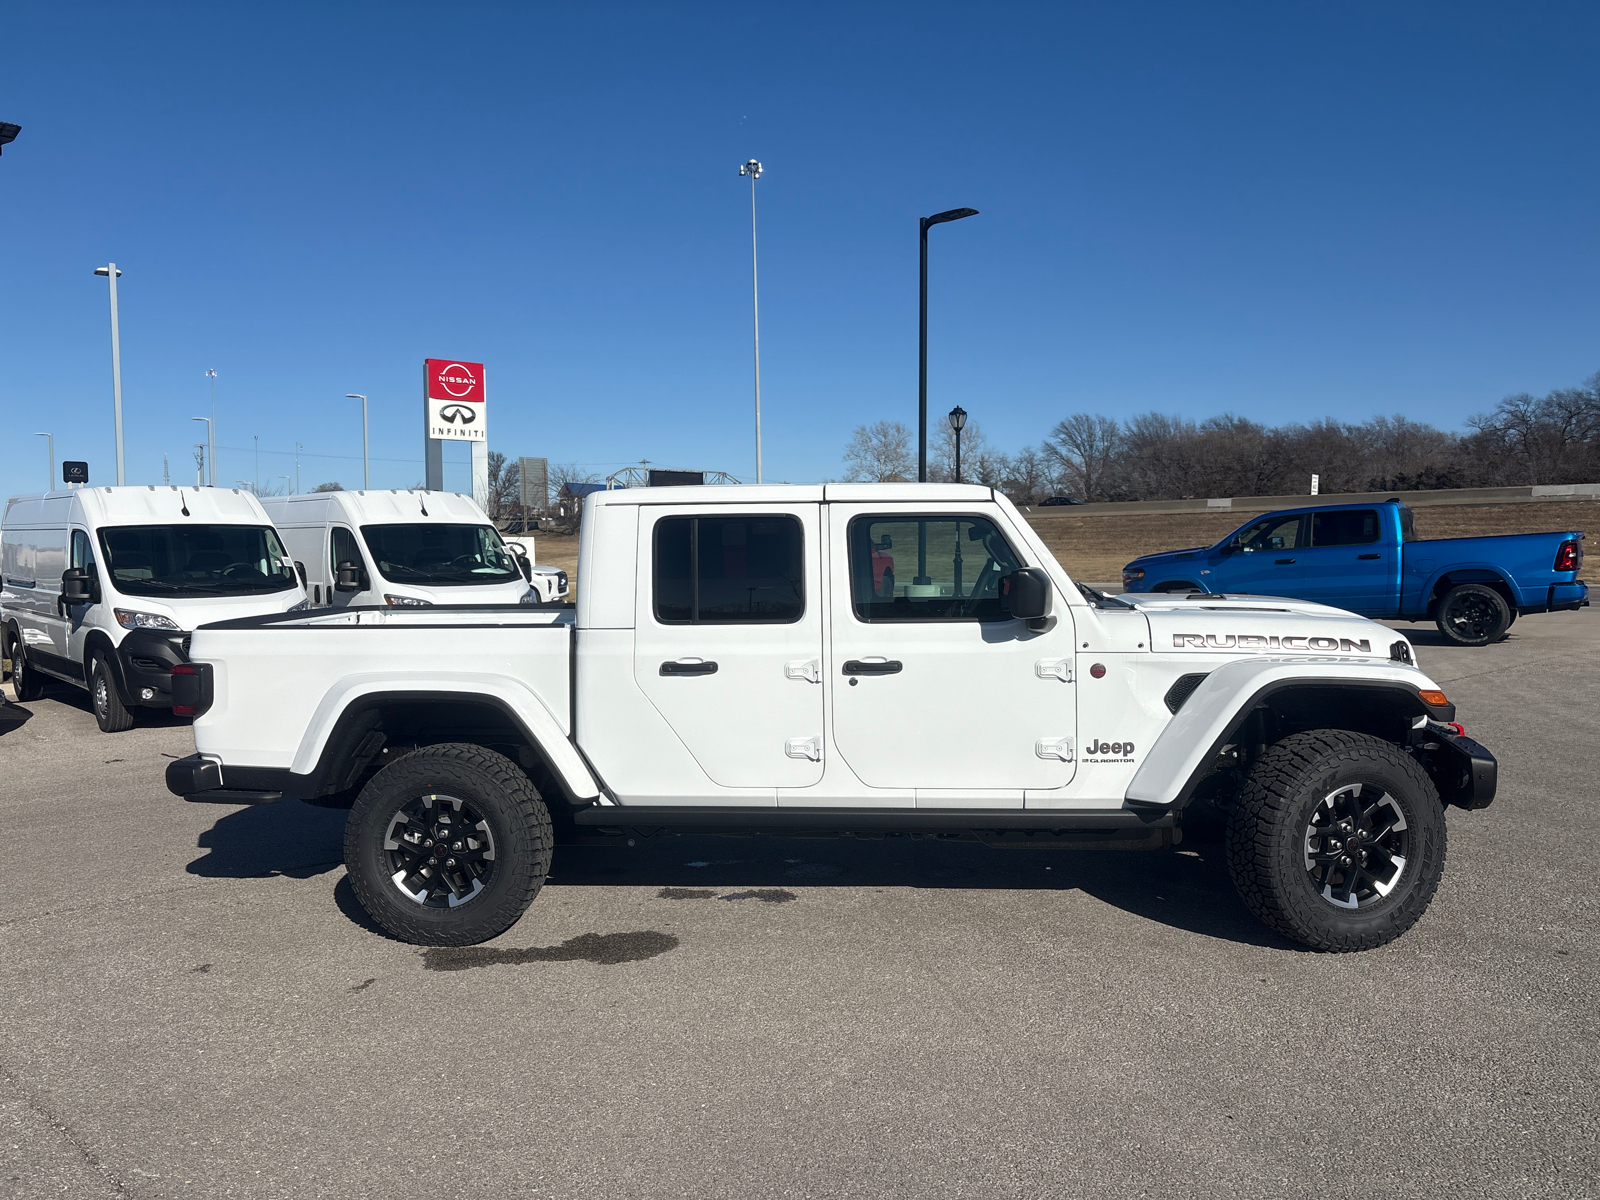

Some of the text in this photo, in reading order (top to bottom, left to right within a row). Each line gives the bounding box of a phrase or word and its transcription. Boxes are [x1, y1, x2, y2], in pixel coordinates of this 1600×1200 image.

[438, 375, 476, 385] NISSAN
[432, 427, 484, 438] INFINITI
[1173, 633, 1372, 653] RUBICON
[1086, 738, 1135, 758] Jeep
